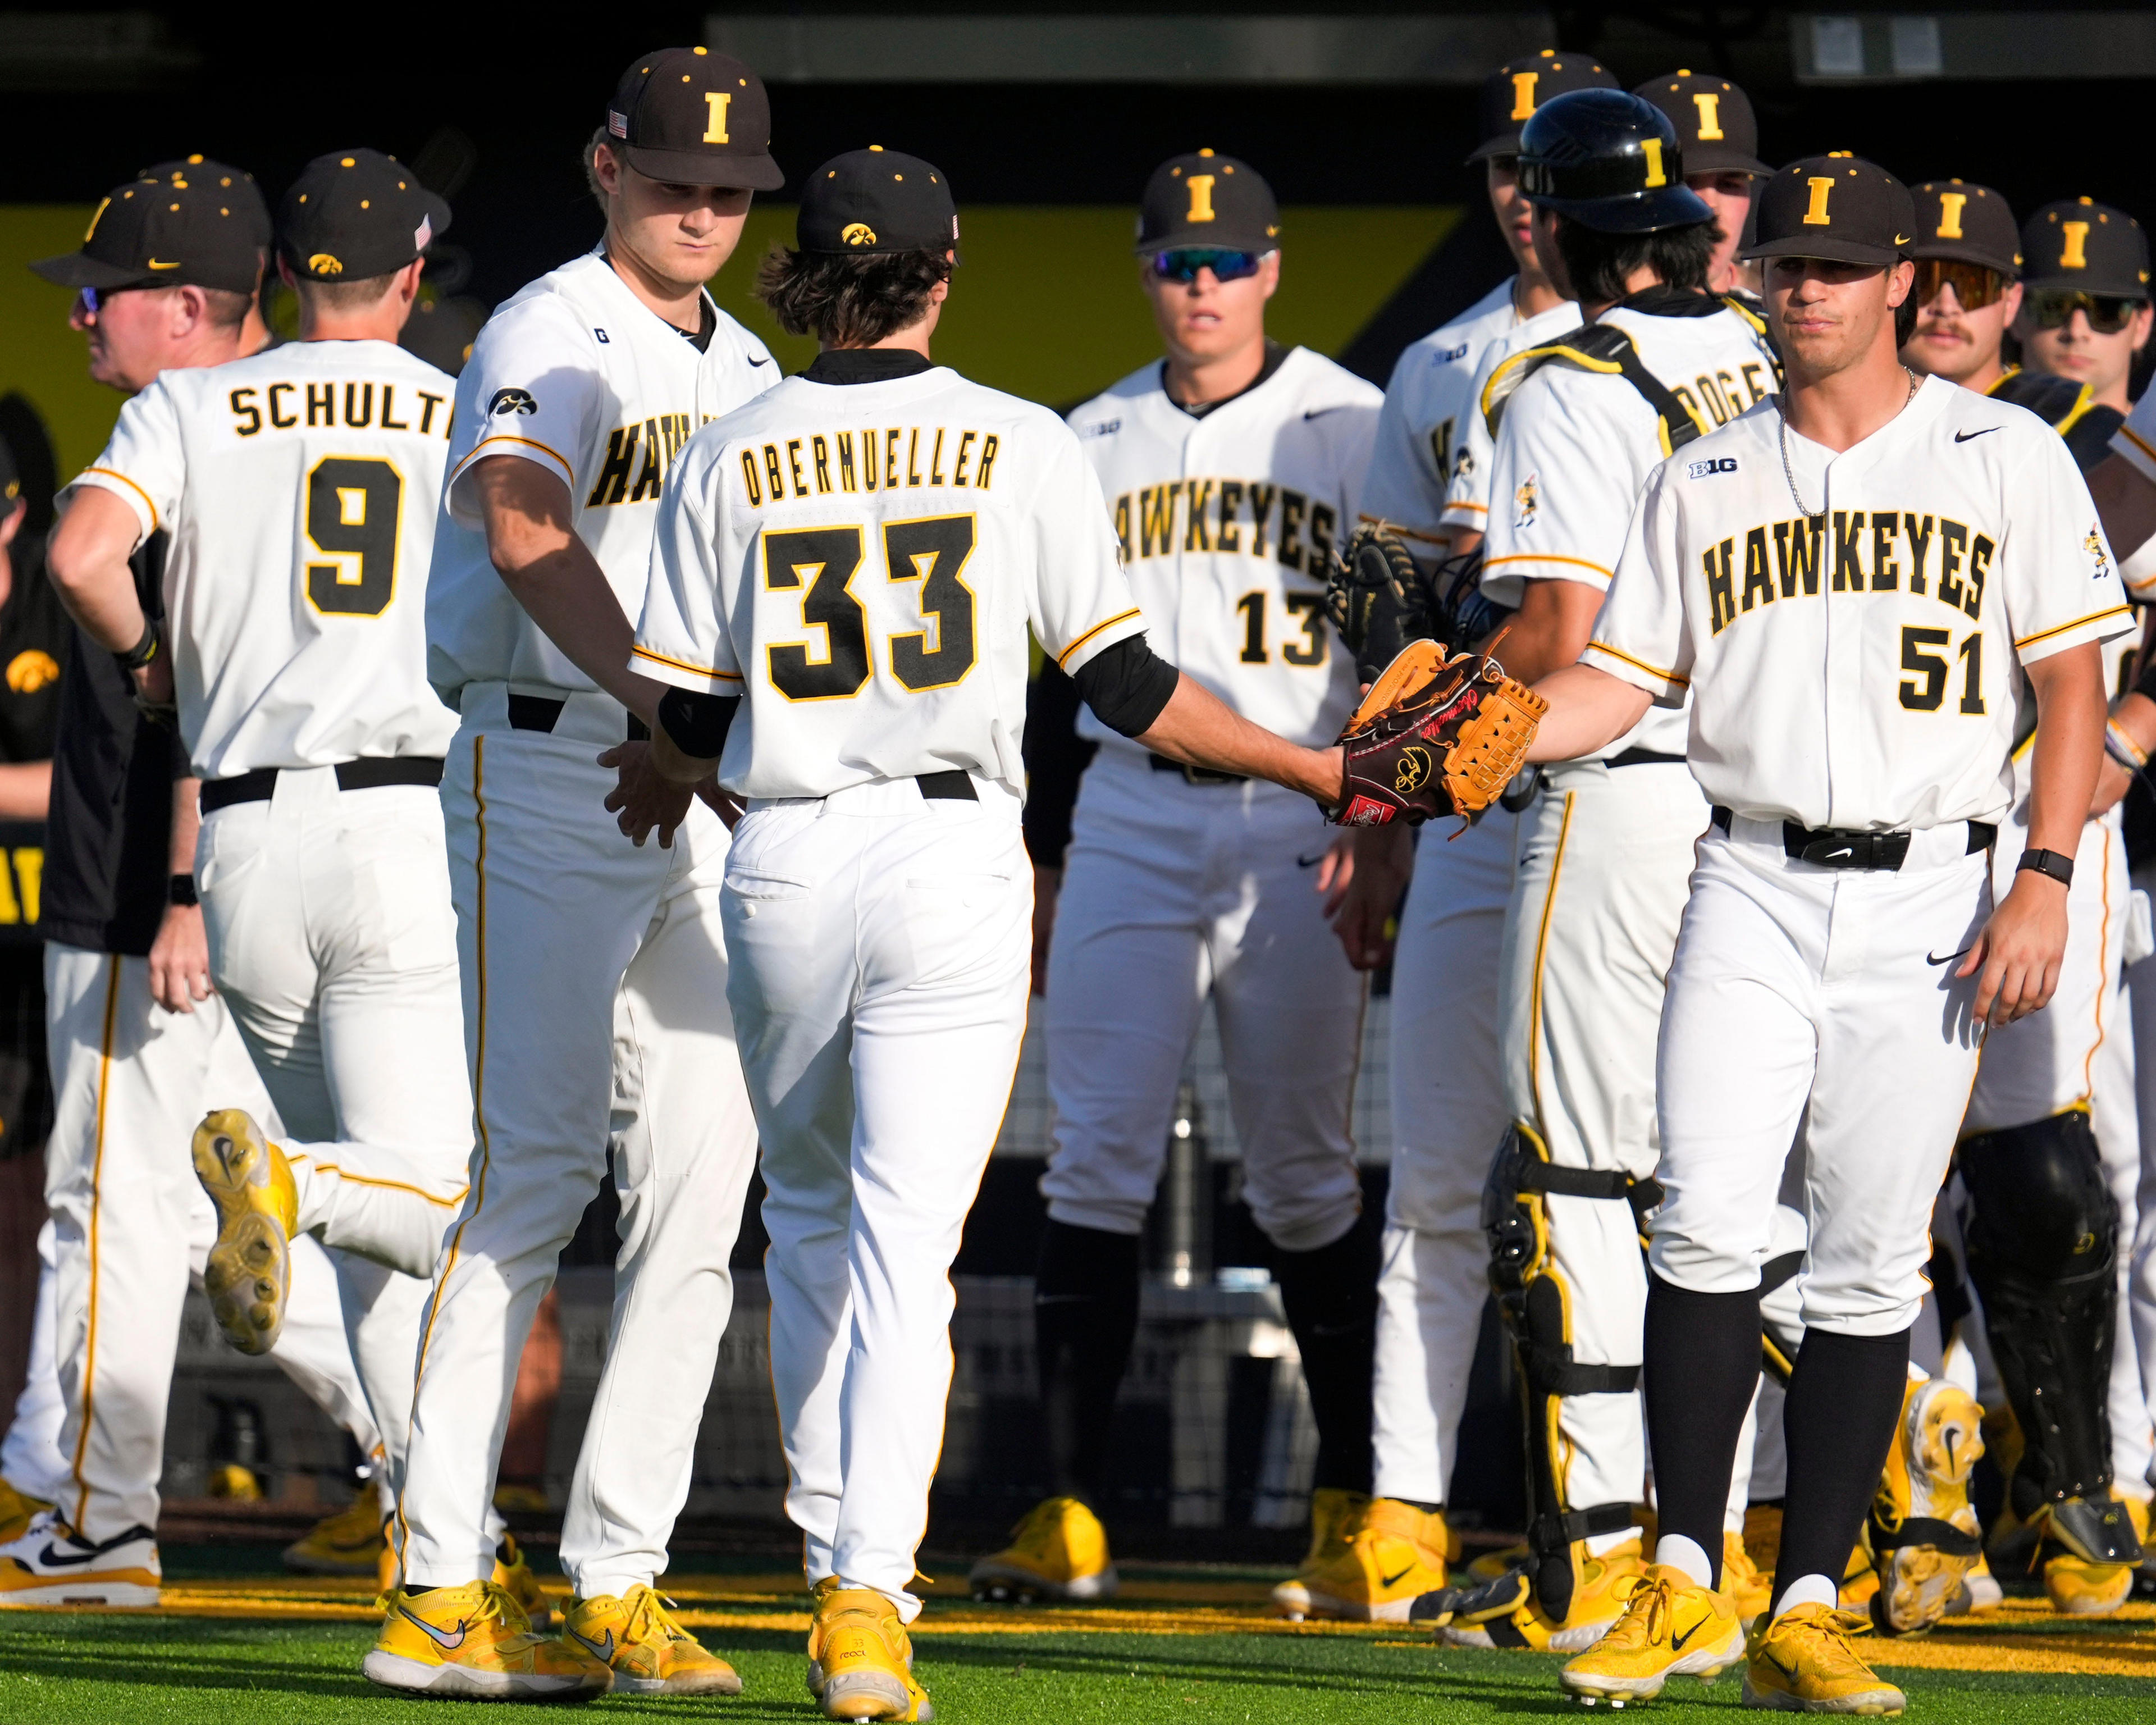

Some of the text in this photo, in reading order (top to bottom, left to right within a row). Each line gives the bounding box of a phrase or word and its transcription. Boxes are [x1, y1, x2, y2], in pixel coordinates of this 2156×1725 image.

[703, 92, 730, 144] I
[1511, 72, 1538, 120] I
[1693, 93, 1724, 140] I
[1641, 138, 1666, 188] I
[1186, 174, 1215, 222] I
[1803, 177, 1834, 225] I
[1936, 193, 1966, 239] I
[2060, 221, 2089, 268] I
[229, 382, 455, 440] SCHULT
[1670, 361, 1781, 428] ROGE
[584, 413, 720, 509] HAW
[739, 426, 1001, 509] OBERMUELLER
[305, 453, 404, 620] 9
[1108, 477, 1338, 584] AWKEYES
[1701, 510, 1996, 638] HAWKEYES
[760, 511, 979, 704] 33
[1236, 588, 1331, 668] 13
[1898, 624, 1988, 716] 51
